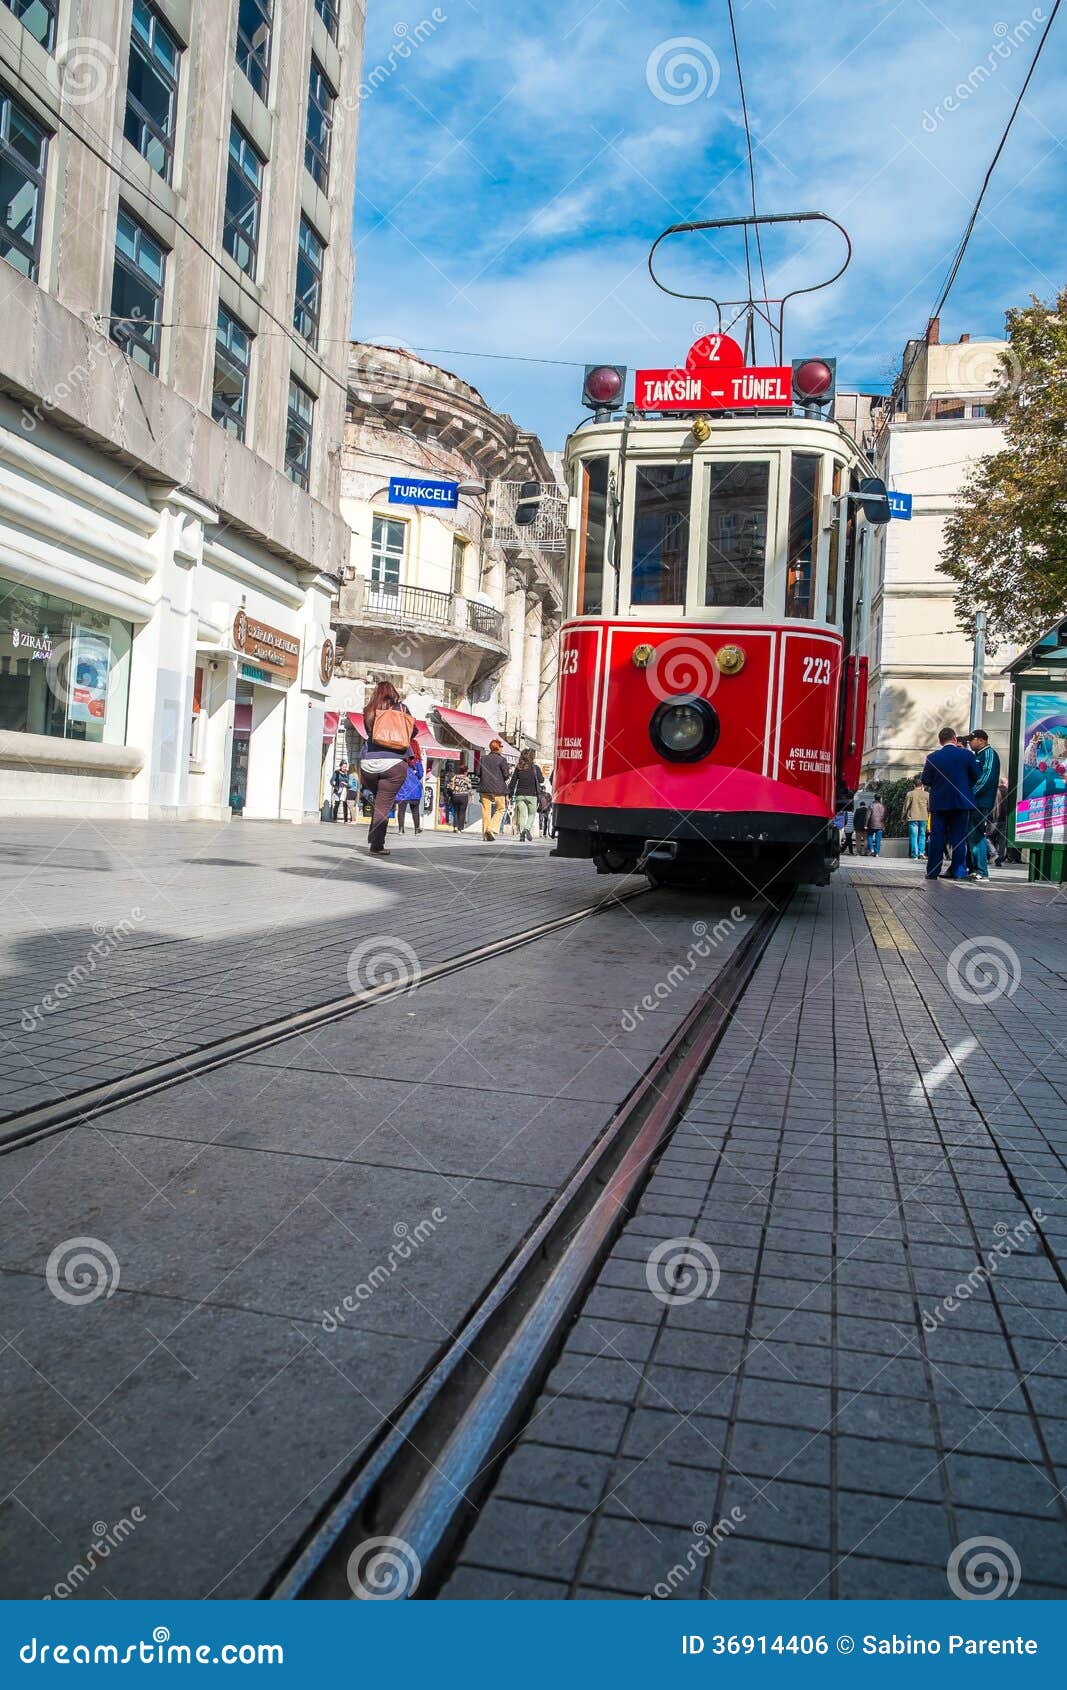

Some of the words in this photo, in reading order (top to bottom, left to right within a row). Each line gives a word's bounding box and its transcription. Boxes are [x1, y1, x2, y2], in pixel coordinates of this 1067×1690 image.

[709, 337, 721, 361] 2
[644, 376, 702, 402] TAKSİM
[731, 375, 787, 401] TÜNEL
[393, 484, 455, 504] TURKCELL
[802, 656, 831, 685] 223
[785, 759, 796, 771] VE
